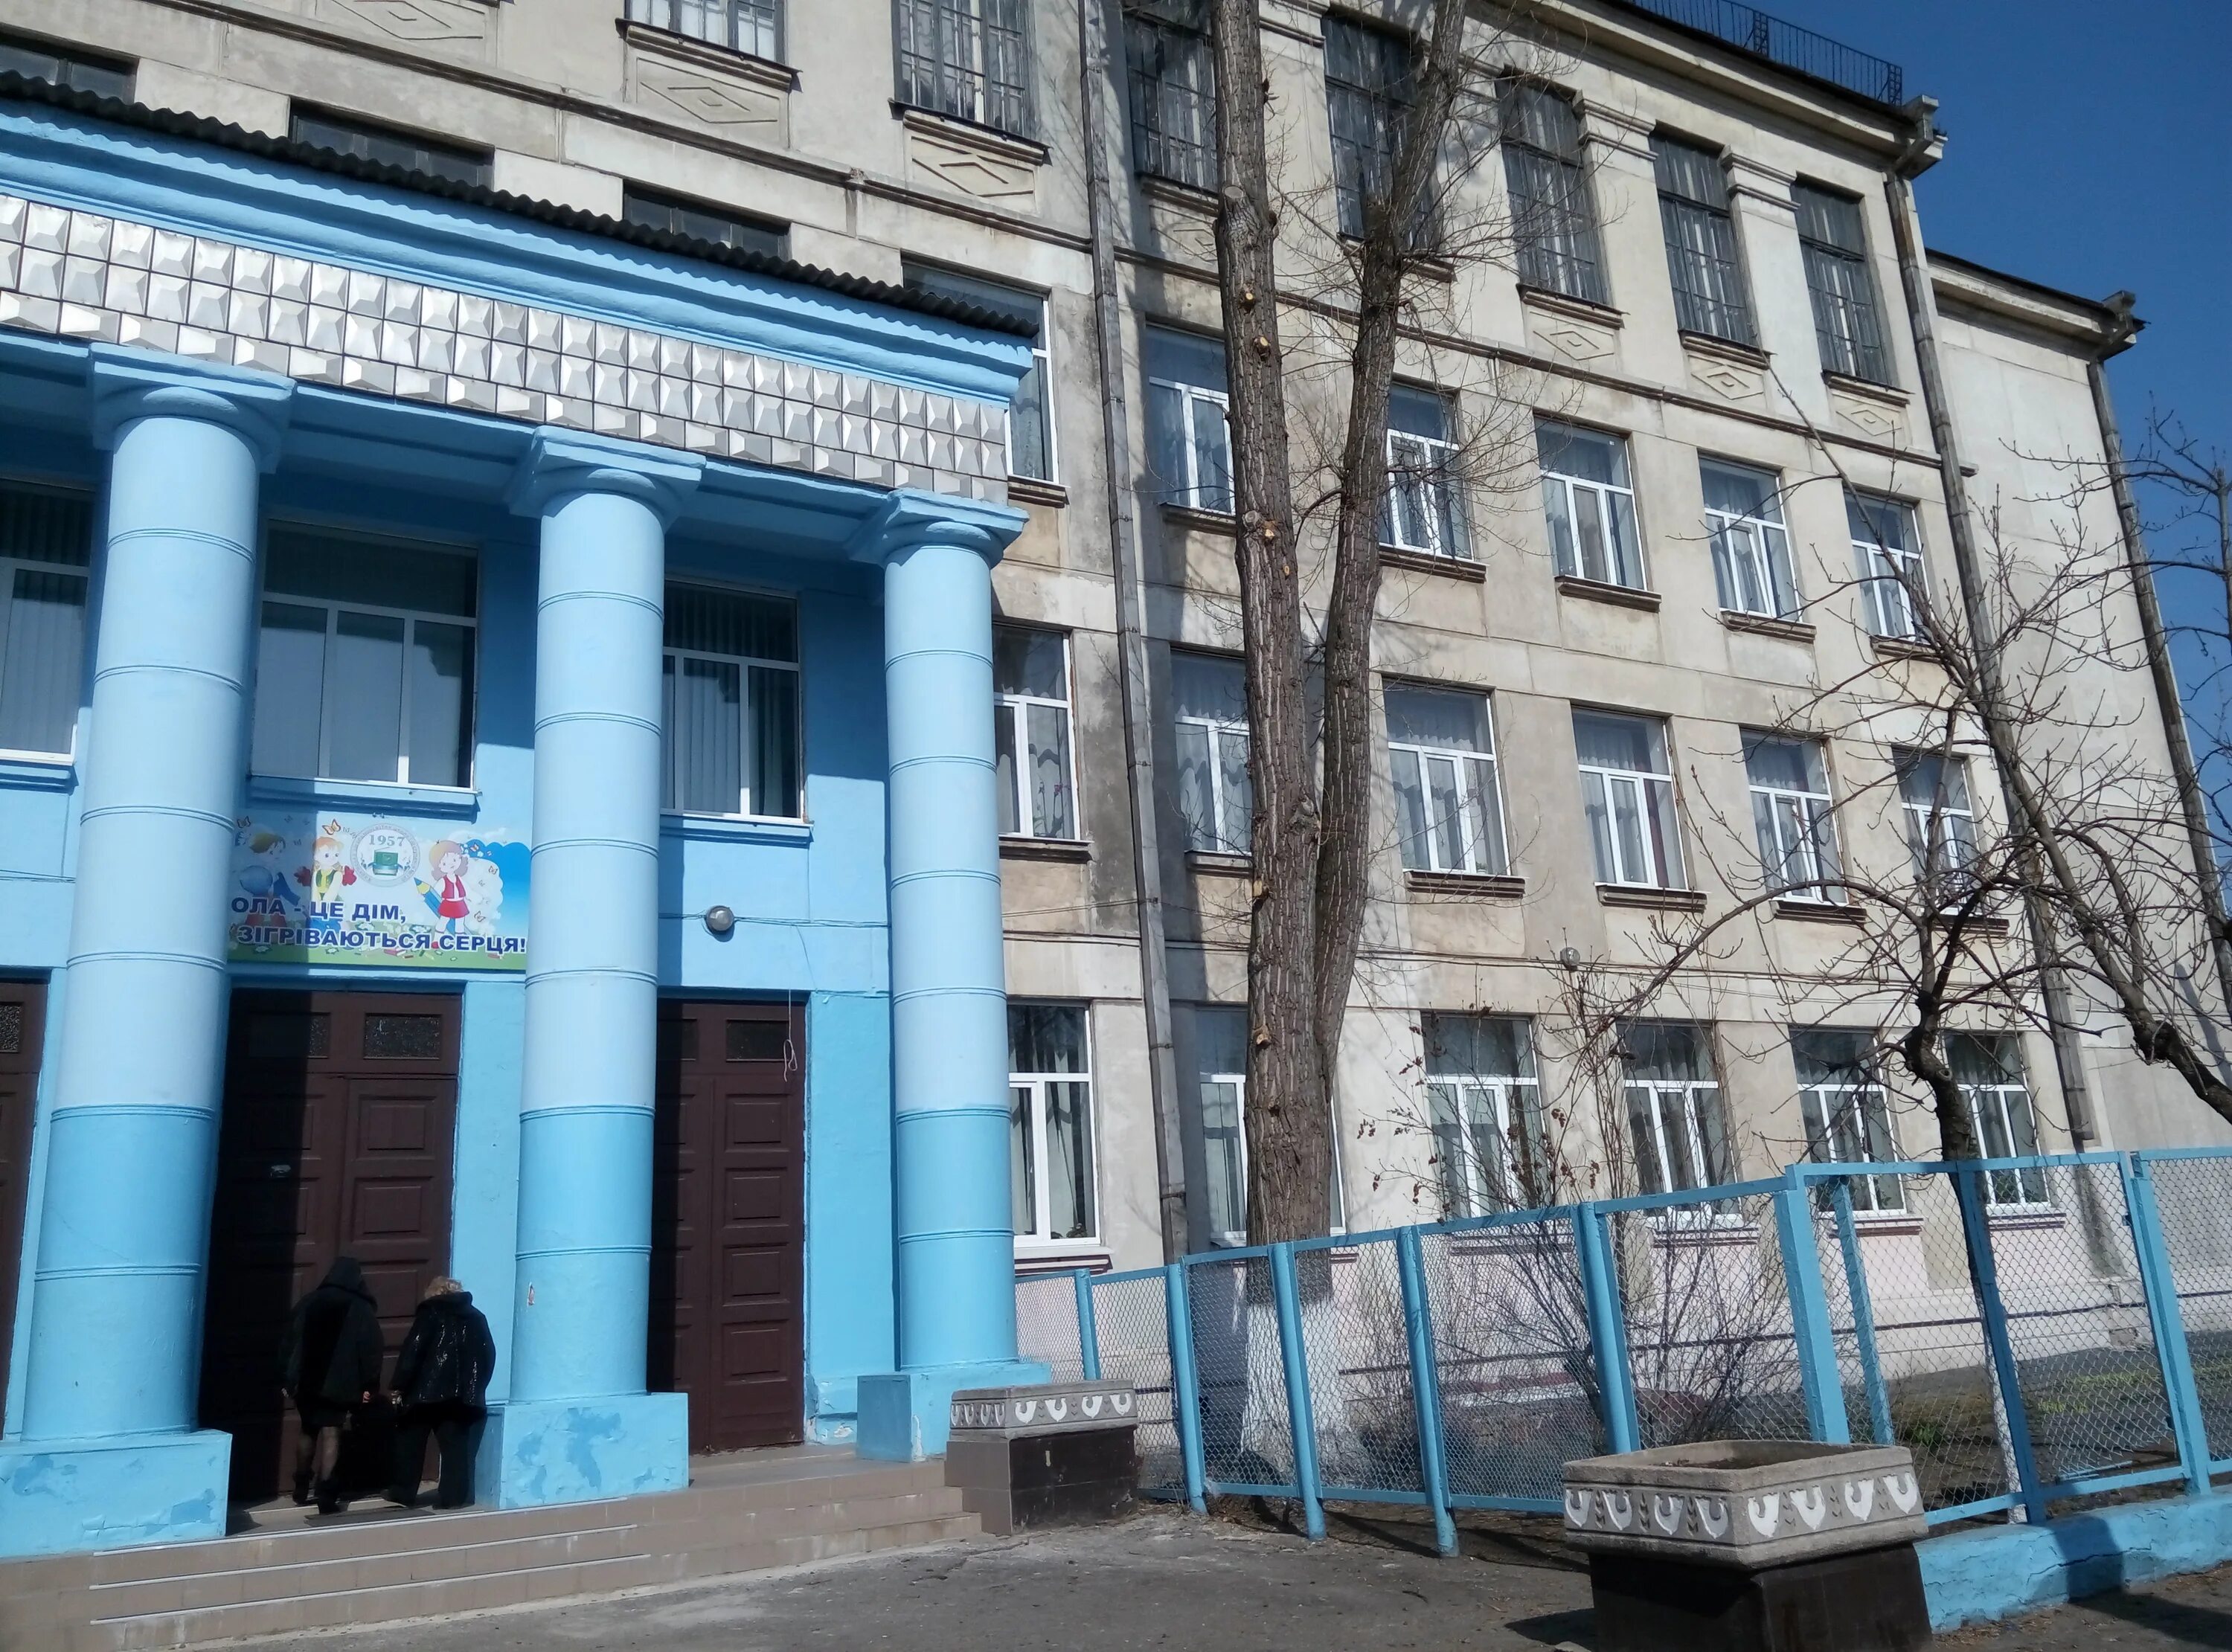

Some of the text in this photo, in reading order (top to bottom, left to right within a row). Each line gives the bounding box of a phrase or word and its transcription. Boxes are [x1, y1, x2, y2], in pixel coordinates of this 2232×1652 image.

[368, 834, 405, 846] 1957
[310, 901, 344, 920] ЦЕ
[351, 903, 406, 923] ДІМ,
[237, 927, 527, 954] ЗІГРІВАЮТЬСЯ СЕРЦЯ!
